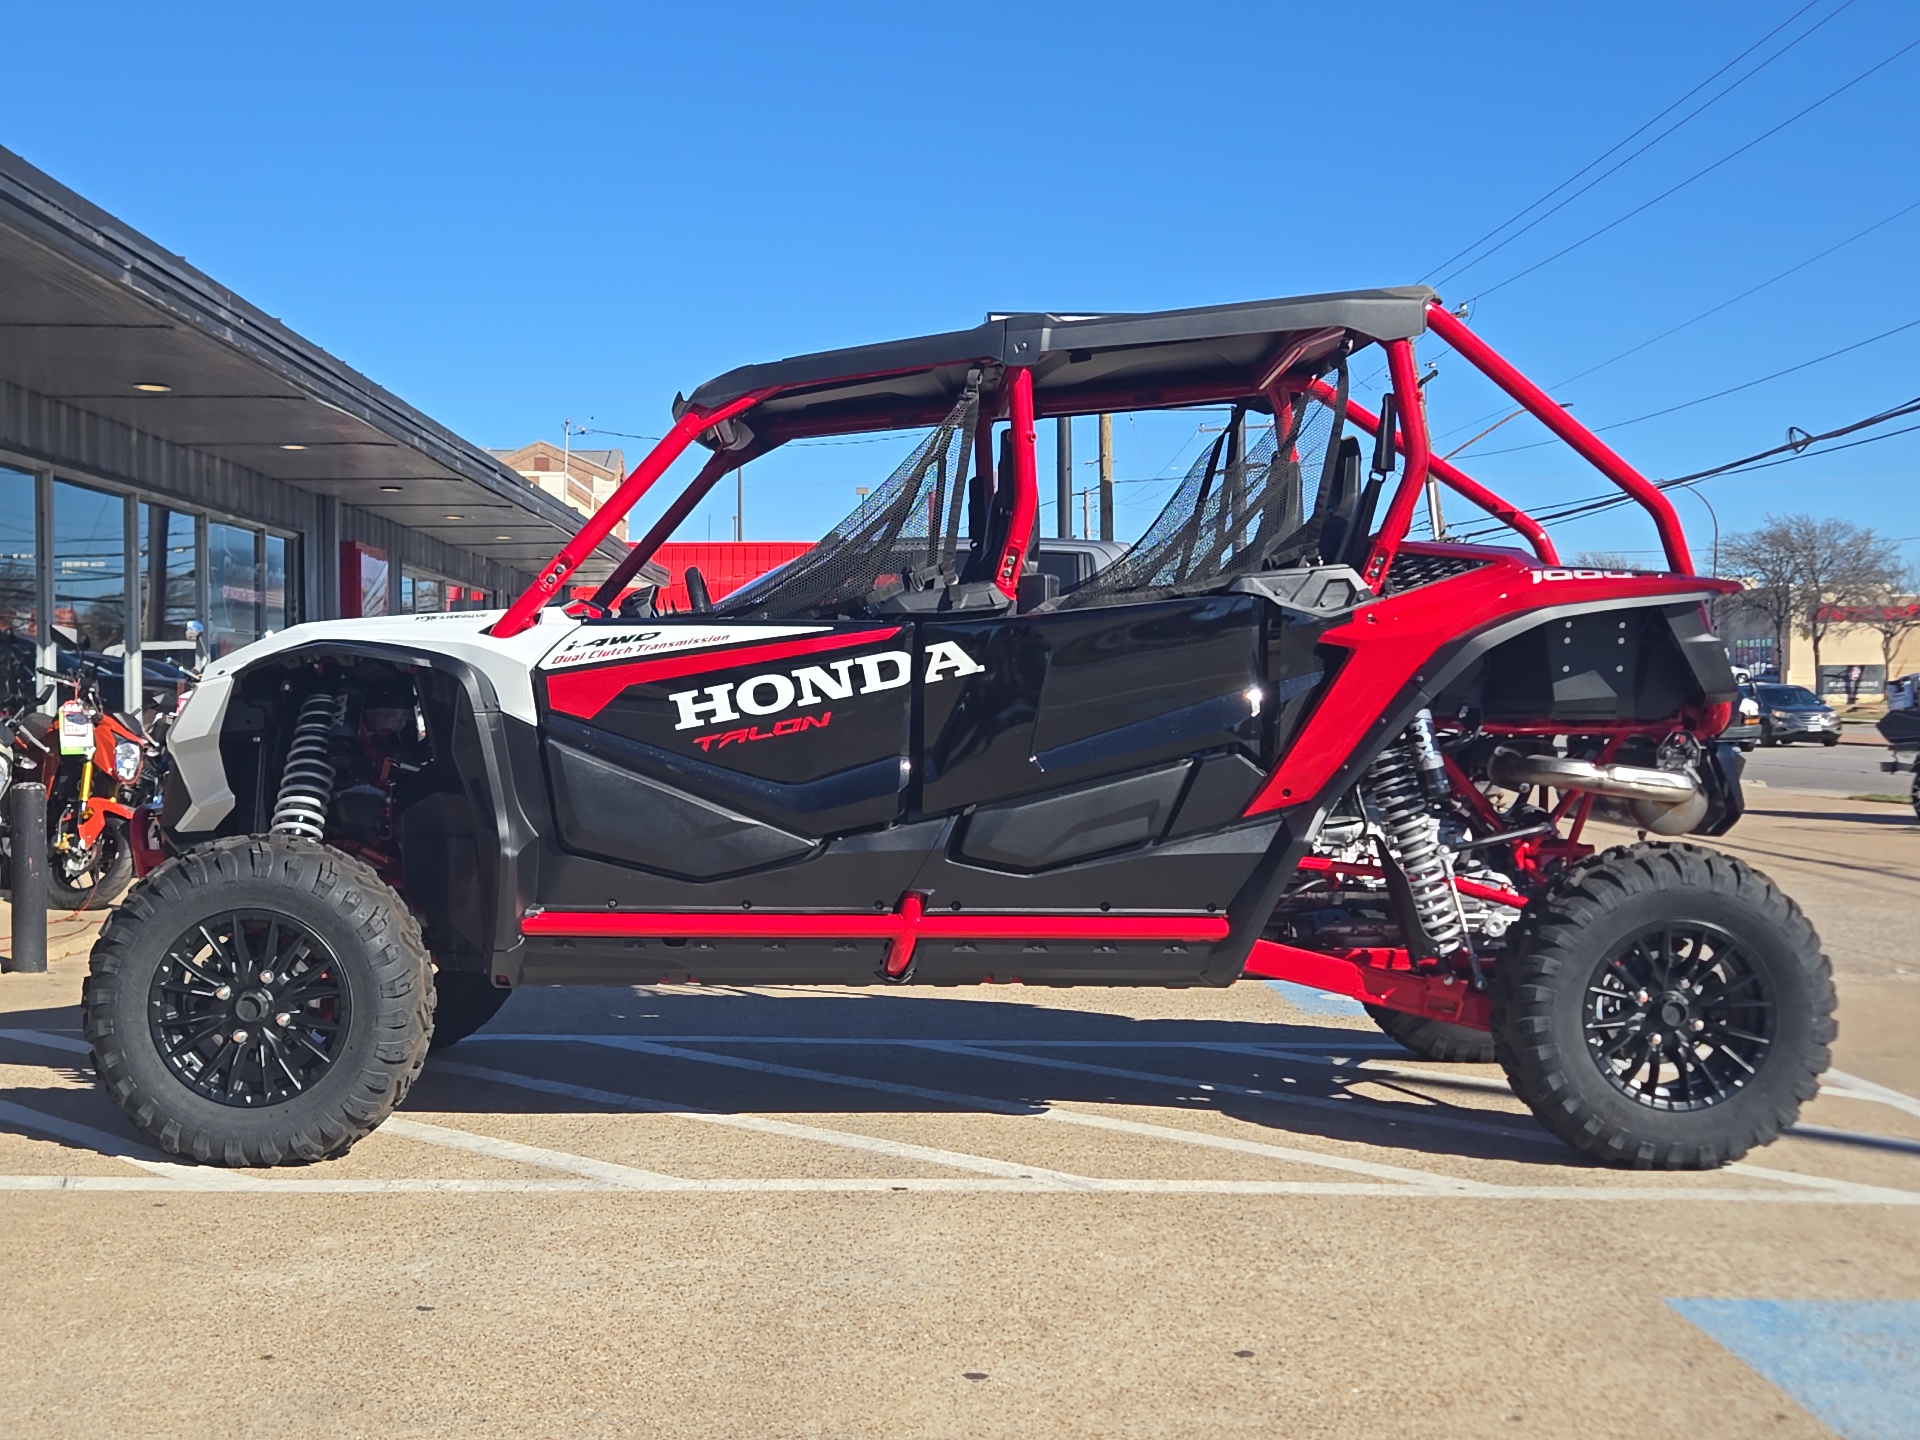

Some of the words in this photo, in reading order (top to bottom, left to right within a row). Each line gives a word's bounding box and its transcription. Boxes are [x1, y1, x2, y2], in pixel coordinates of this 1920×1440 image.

[551, 652, 586, 665] Dual
[588, 646, 632, 660] Clutch
[637, 634, 730, 653] Transmission
[564, 632, 661, 652] i-4WD
[668, 640, 985, 730] HONDA
[692, 711, 832, 752] TALON
